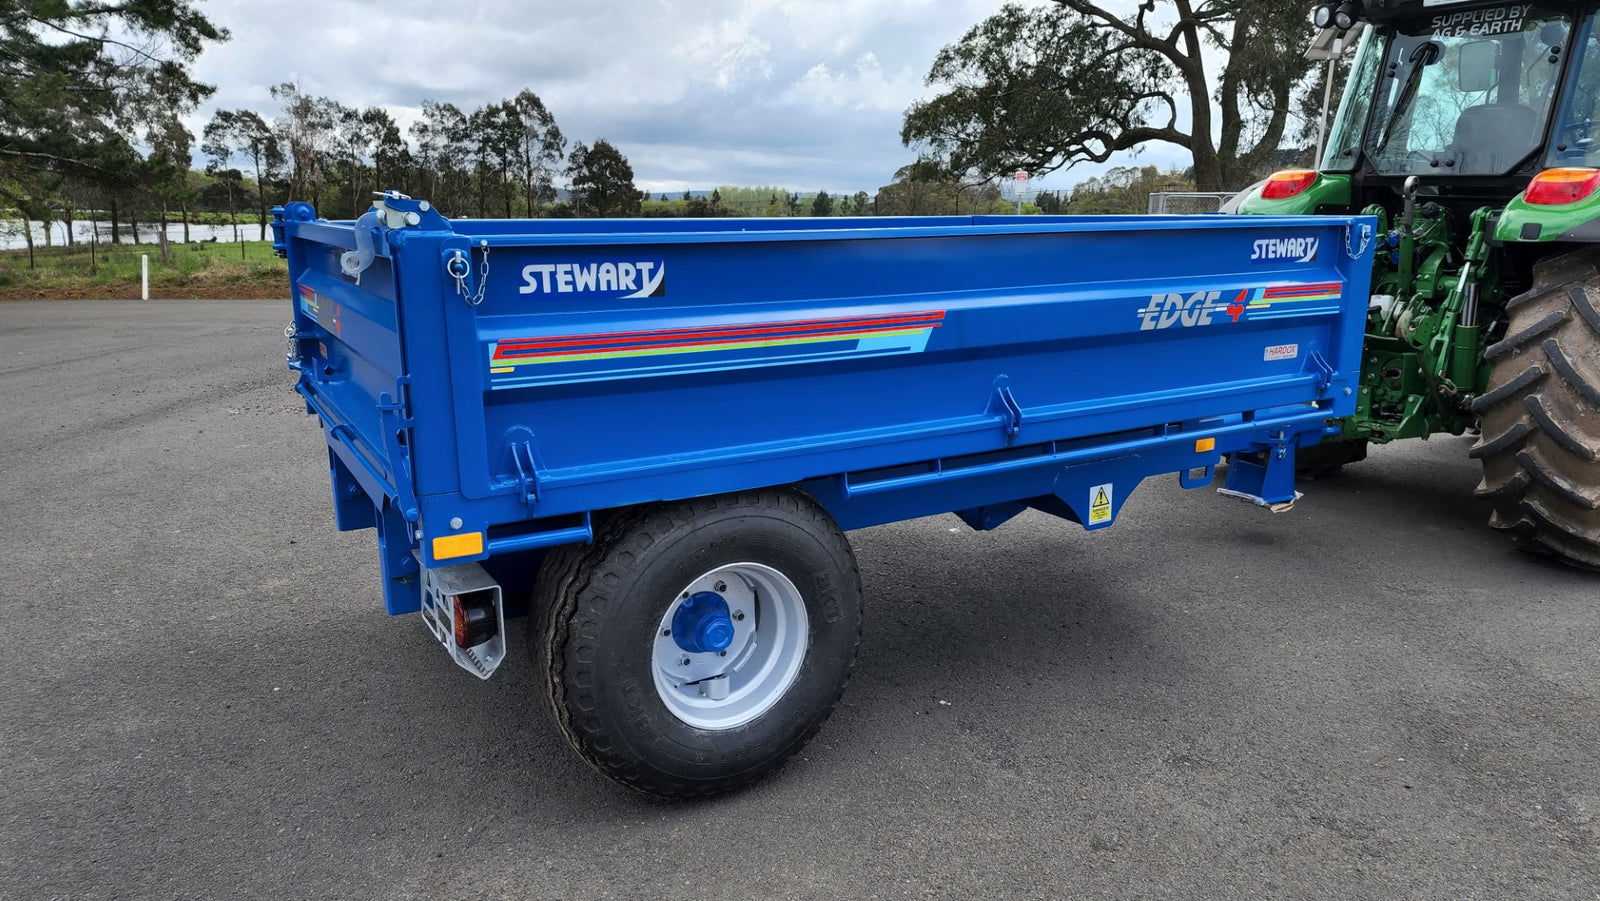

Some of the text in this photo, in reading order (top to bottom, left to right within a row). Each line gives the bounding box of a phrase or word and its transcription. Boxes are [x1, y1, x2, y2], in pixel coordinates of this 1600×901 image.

[1431, 4, 1532, 28] SUPPLIED BY
[1431, 19, 1523, 40] AG & EARTH
[1251, 237, 1319, 263] STEWART
[519, 259, 665, 299] STEWART
[1138, 288, 1248, 331] EDGE 4
[1269, 344, 1297, 356] HARDOX
